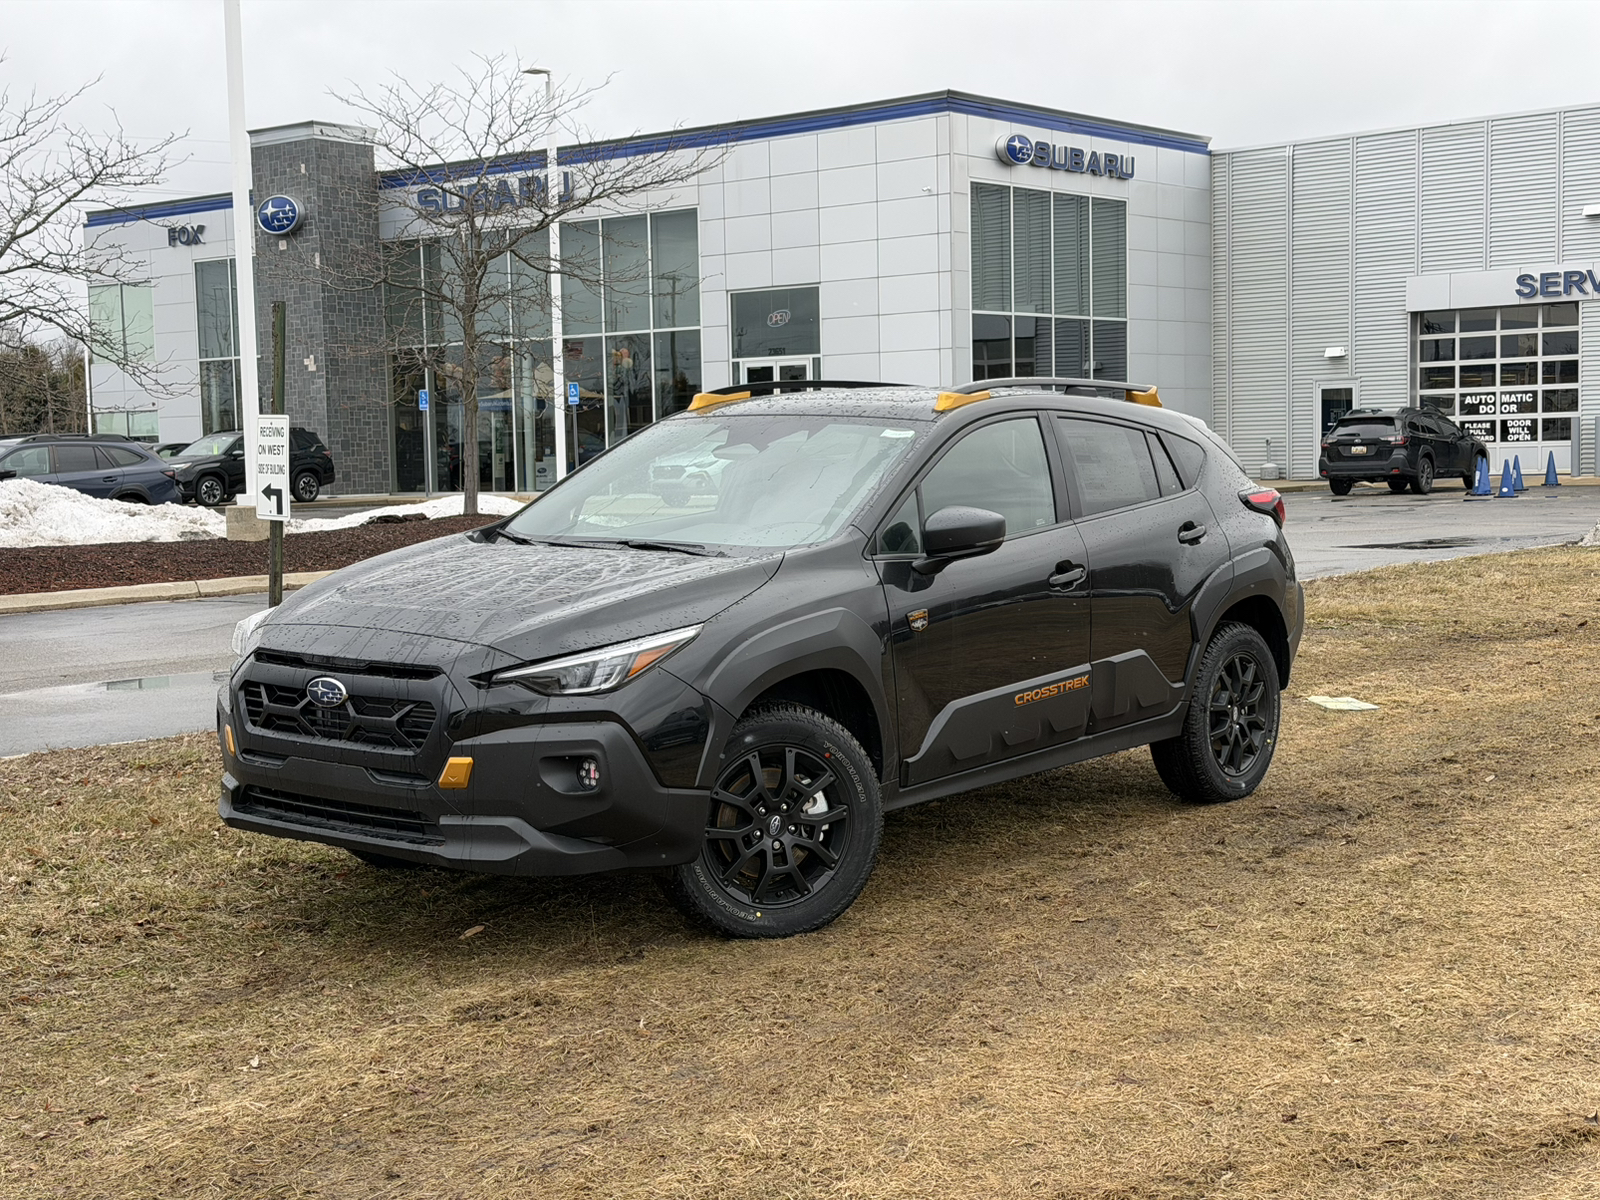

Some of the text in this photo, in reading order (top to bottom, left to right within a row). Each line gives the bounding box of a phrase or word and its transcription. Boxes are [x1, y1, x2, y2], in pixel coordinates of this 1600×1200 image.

[1032, 140, 1136, 179] SUBARU
[417, 171, 571, 213] SUBARU
[168, 225, 206, 247] FOX
[768, 312, 789, 325] OPEN
[1464, 393, 1533, 404] AUTO MATIC
[1479, 404, 1518, 413] DO OR
[260, 426, 285, 438] RECEIVING
[258, 444, 285, 455] ON WEST
[270, 463, 285, 475] BUILDING
[1014, 674, 1090, 706] CROSSTREK
[823, 740, 867, 803] YOKOHAMA
[694, 865, 757, 922] GEOLANDAR
